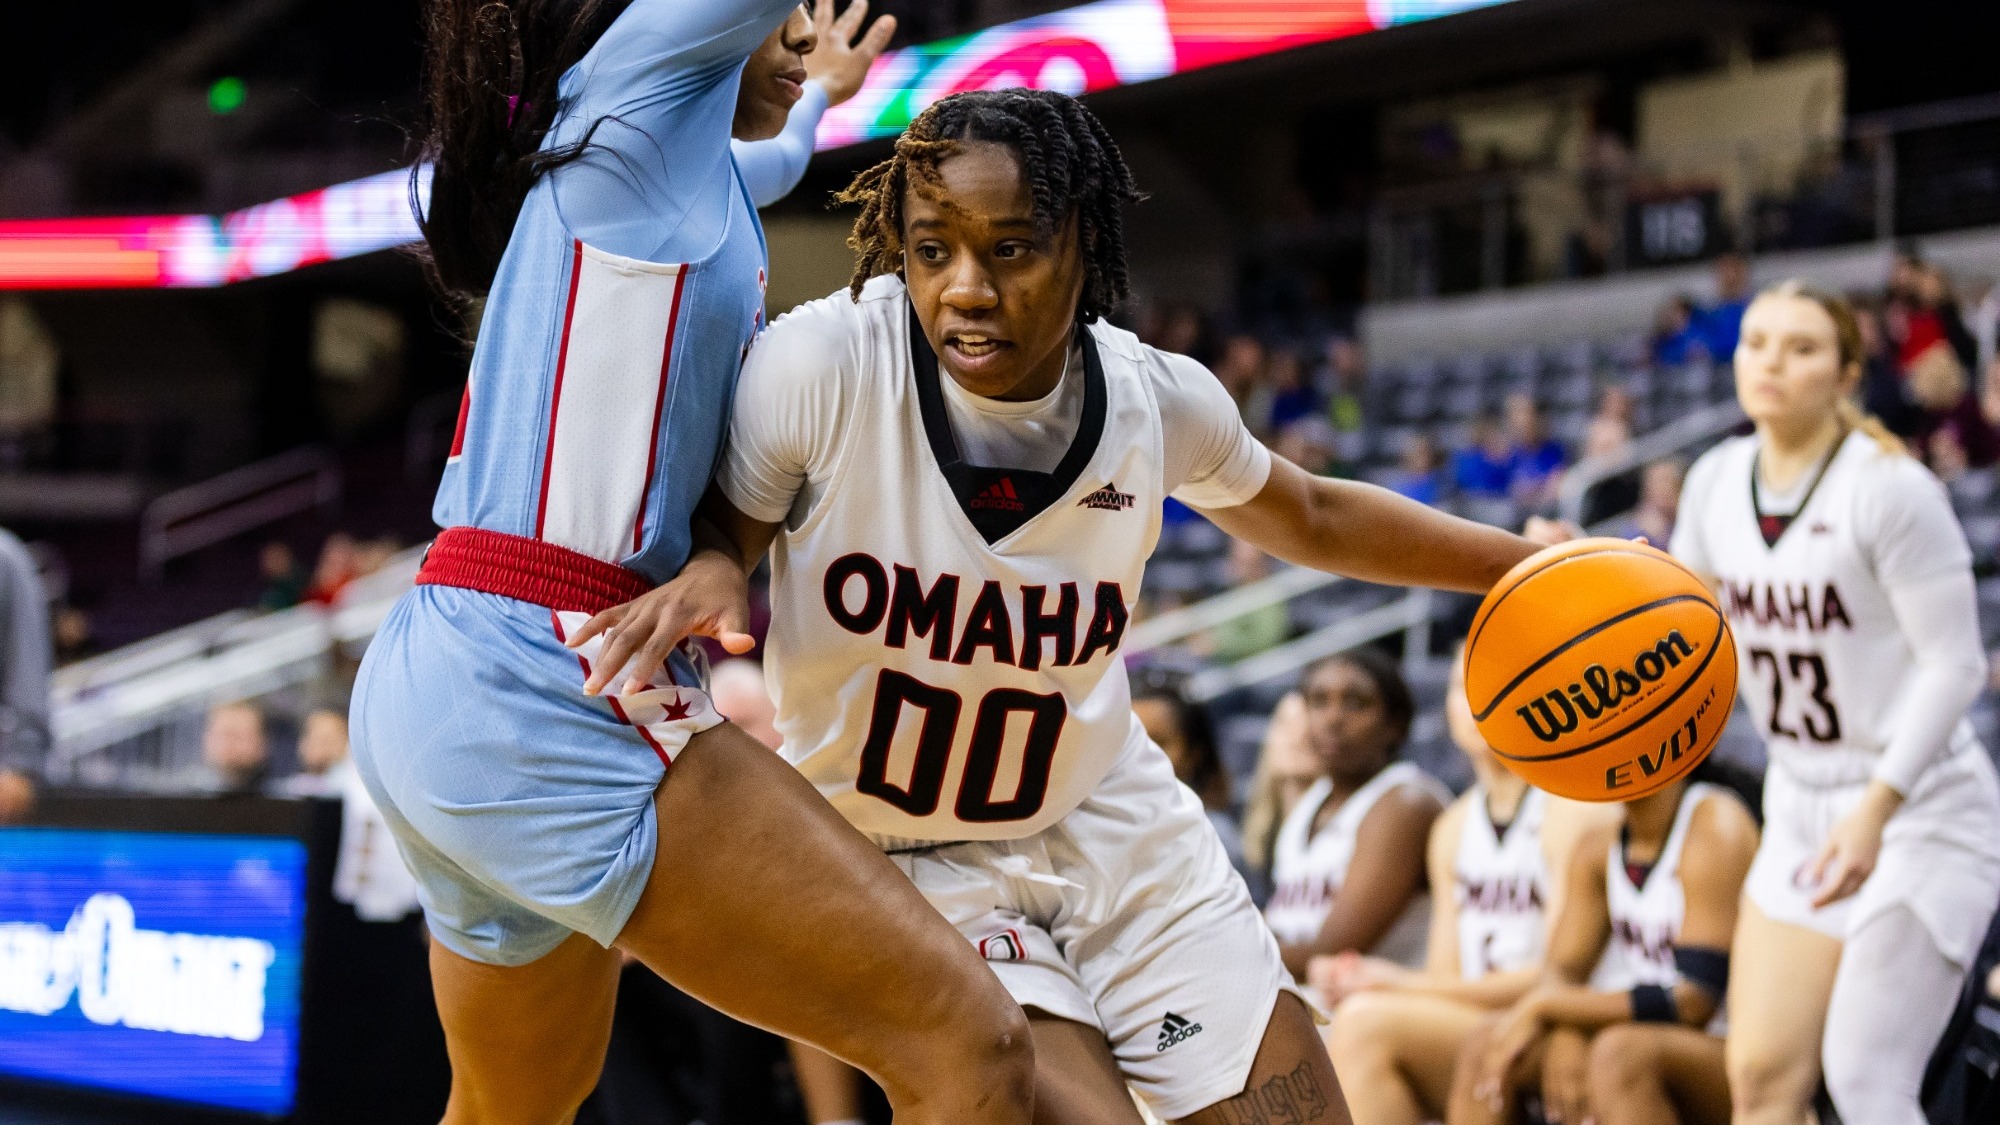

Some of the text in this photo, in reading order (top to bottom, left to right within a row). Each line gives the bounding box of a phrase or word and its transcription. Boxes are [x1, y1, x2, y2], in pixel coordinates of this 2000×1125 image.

[970, 497, 1025, 512] adidas
[823, 552, 1129, 672] OMAHA
[1716, 577, 1853, 632] MAHA
[1516, 628, 1694, 742] Wilson
[1748, 648, 1842, 743] 23
[856, 667, 1067, 823] 00
[1157, 1022, 1203, 1052] adidas
